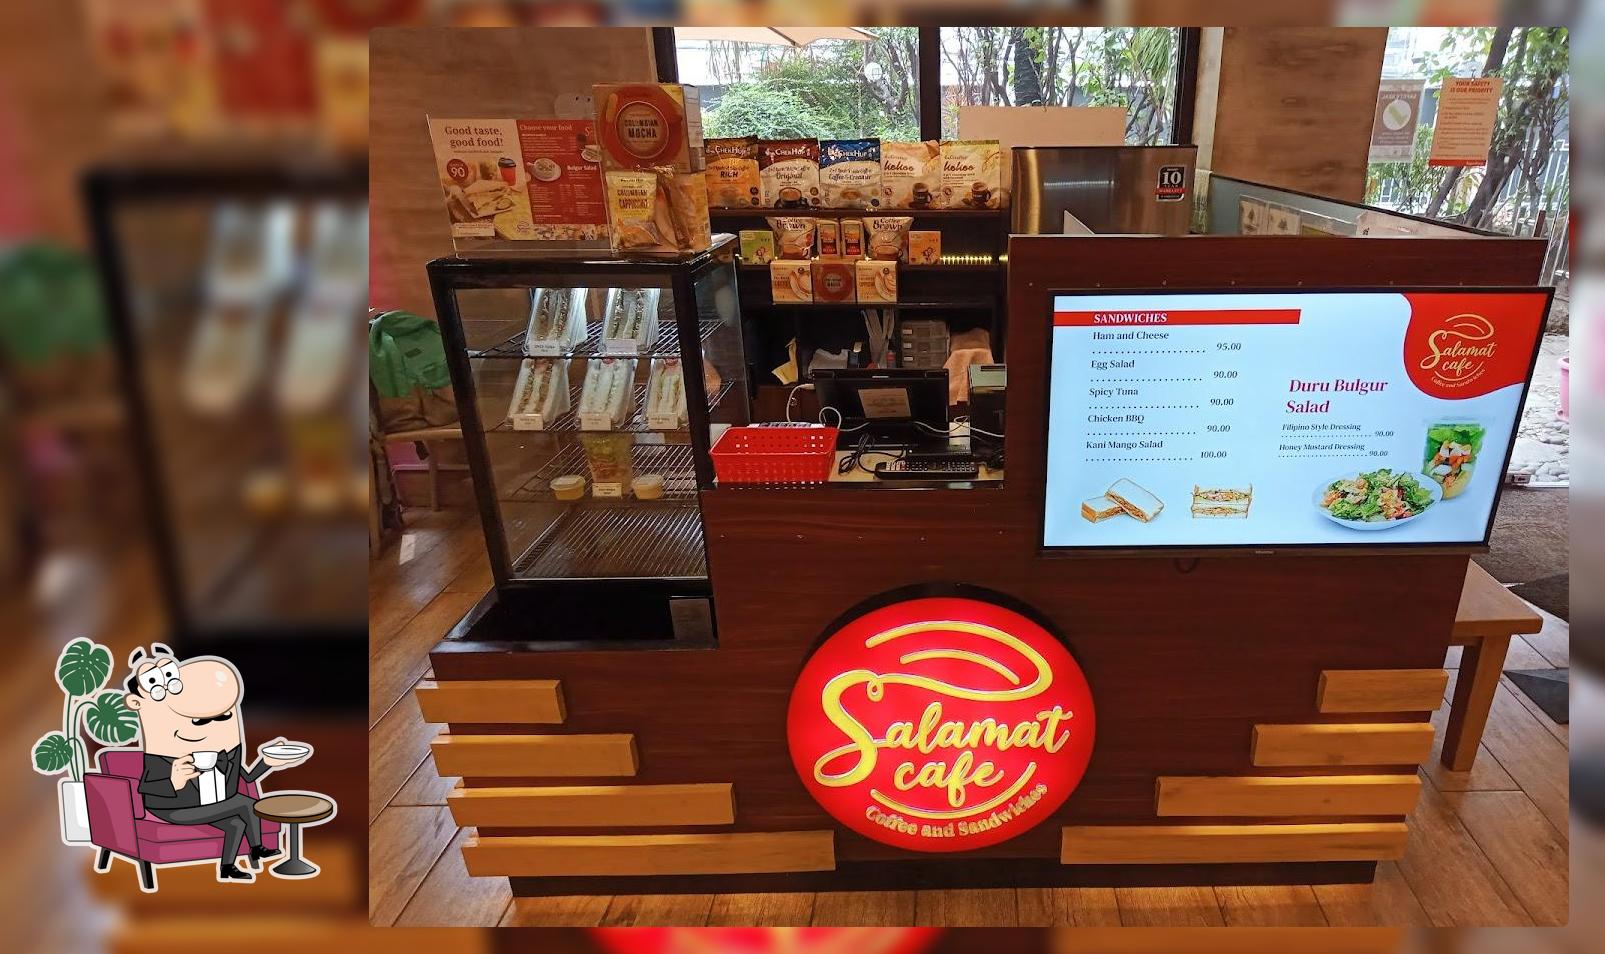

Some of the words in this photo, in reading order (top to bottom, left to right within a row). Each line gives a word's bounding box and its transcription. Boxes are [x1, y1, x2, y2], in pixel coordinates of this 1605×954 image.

[445, 126, 472, 135] Good
[628, 127, 657, 139] MOCHA
[450, 138, 475, 149] good
[477, 138, 504, 147] food!
[451, 166, 466, 178] 90
[720, 170, 738, 178] RICH
[776, 172, 803, 181] Original
[1162, 171, 1182, 185] 10
[872, 219, 902, 231] Brown
[1093, 312, 1168, 324] SANDWICHES
[1092, 331, 1115, 340] Ham
[1116, 331, 1134, 340] and
[1136, 331, 1169, 340] Cheese
[1216, 342, 1242, 351] 95.00
[1420, 330, 1498, 370] Salamat
[1090, 360, 1108, 370] Egg
[1109, 359, 1135, 369] Salad
[1442, 358, 1474, 376] cafe
[1213, 370, 1238, 379] 90.00
[1089, 387, 1114, 397] Spicy
[1115, 387, 1139, 396] Tuna
[1289, 379, 1329, 392] Duru
[1334, 379, 1388, 396] Bulgur
[1209, 398, 1234, 406] 90.00
[1285, 400, 1330, 414] Salad
[1087, 414, 1124, 423] Chicken
[1125, 414, 1145, 425] BBQ
[1206, 425, 1231, 433] 90.00
[1282, 424, 1310, 432] Filipino
[1310, 424, 1329, 432] Style
[1330, 423, 1361, 431] Dressing
[1086, 440, 1106, 449] Kani
[1107, 441, 1137, 451] Mango
[1138, 440, 1163, 449] Salad
[1279, 444, 1302, 452] Honey
[1334, 443, 1365, 451] Dressing
[1200, 451, 1227, 459] 100.00
[813, 669, 1074, 787] Salamat
[893, 750, 1005, 808] cafe
[865, 805, 918, 838] Coffee
[920, 823, 956, 838] and
[958, 783, 1048, 837] Sandwiches
